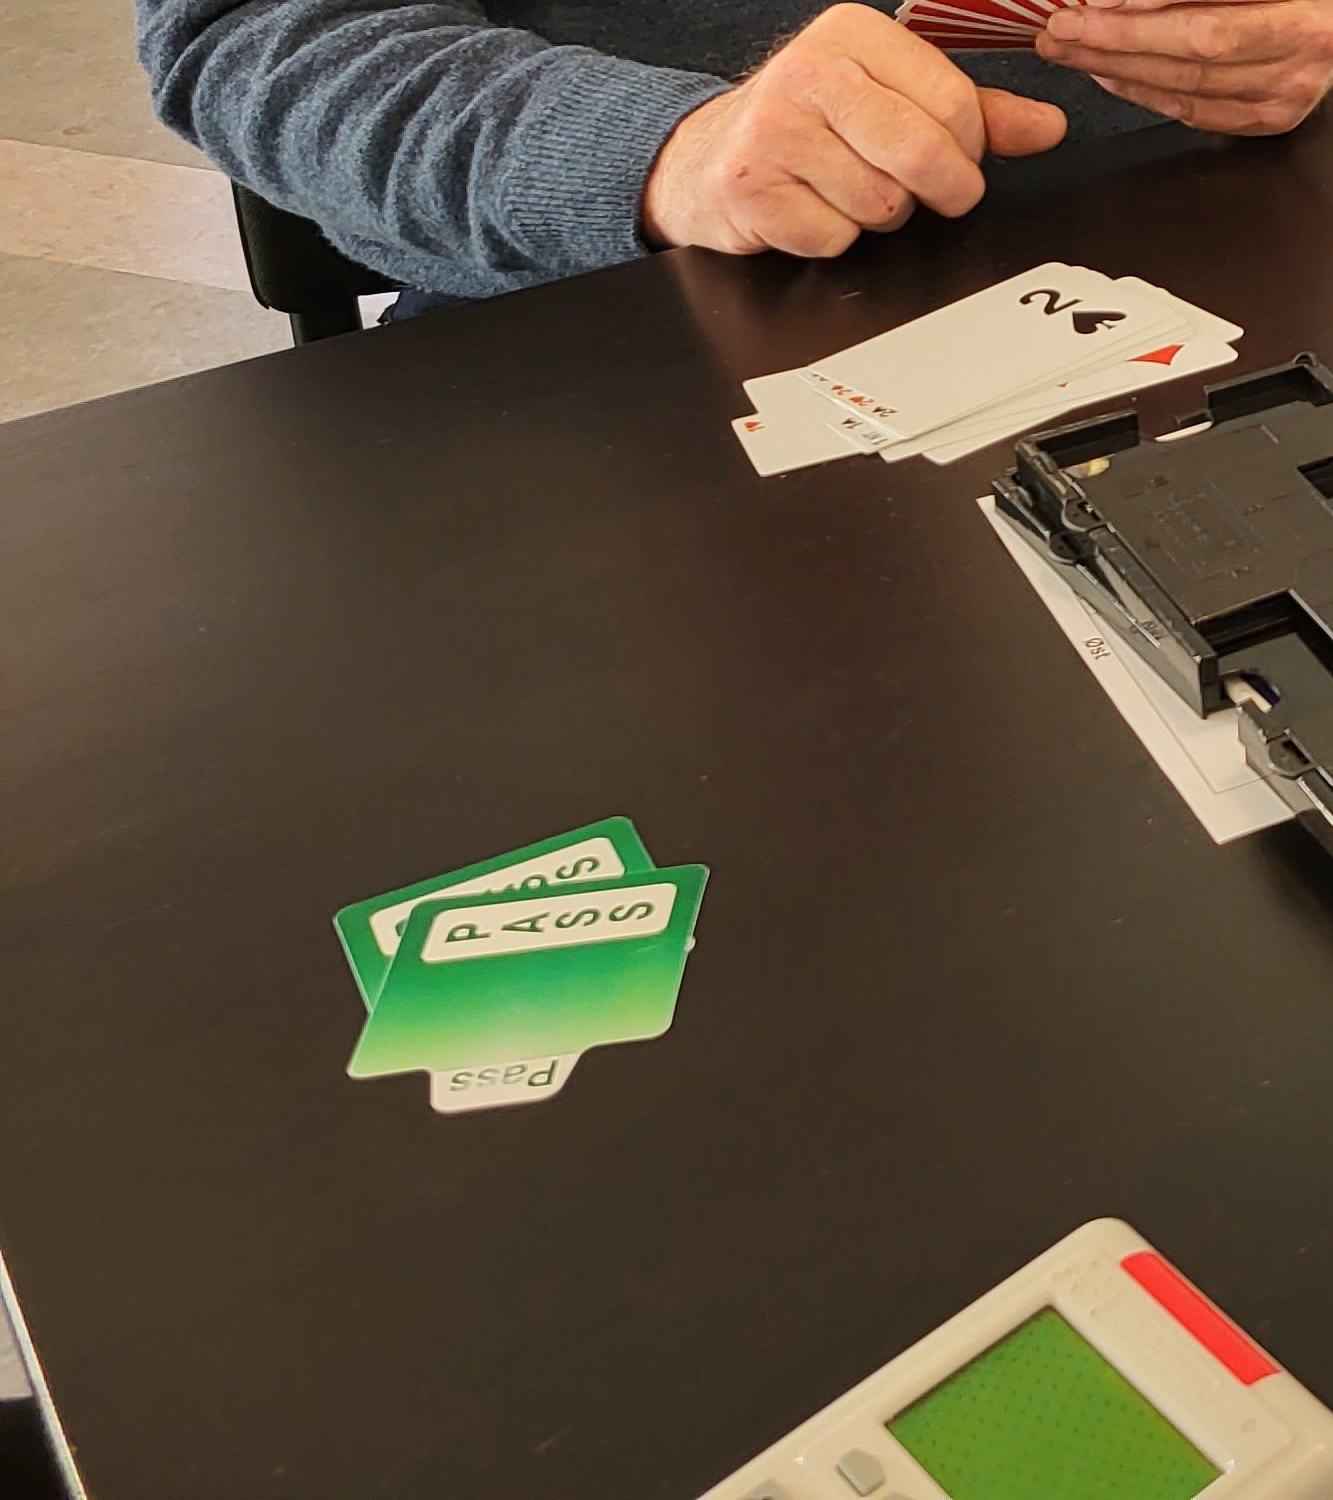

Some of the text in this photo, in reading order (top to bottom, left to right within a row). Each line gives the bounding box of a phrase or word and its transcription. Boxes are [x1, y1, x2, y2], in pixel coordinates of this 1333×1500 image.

[1019, 288, 1083, 315] 2
[1083, 637, 1112, 661] Øst
[445, 900, 656, 944] PASS
[449, 1060, 559, 1092] Pass
